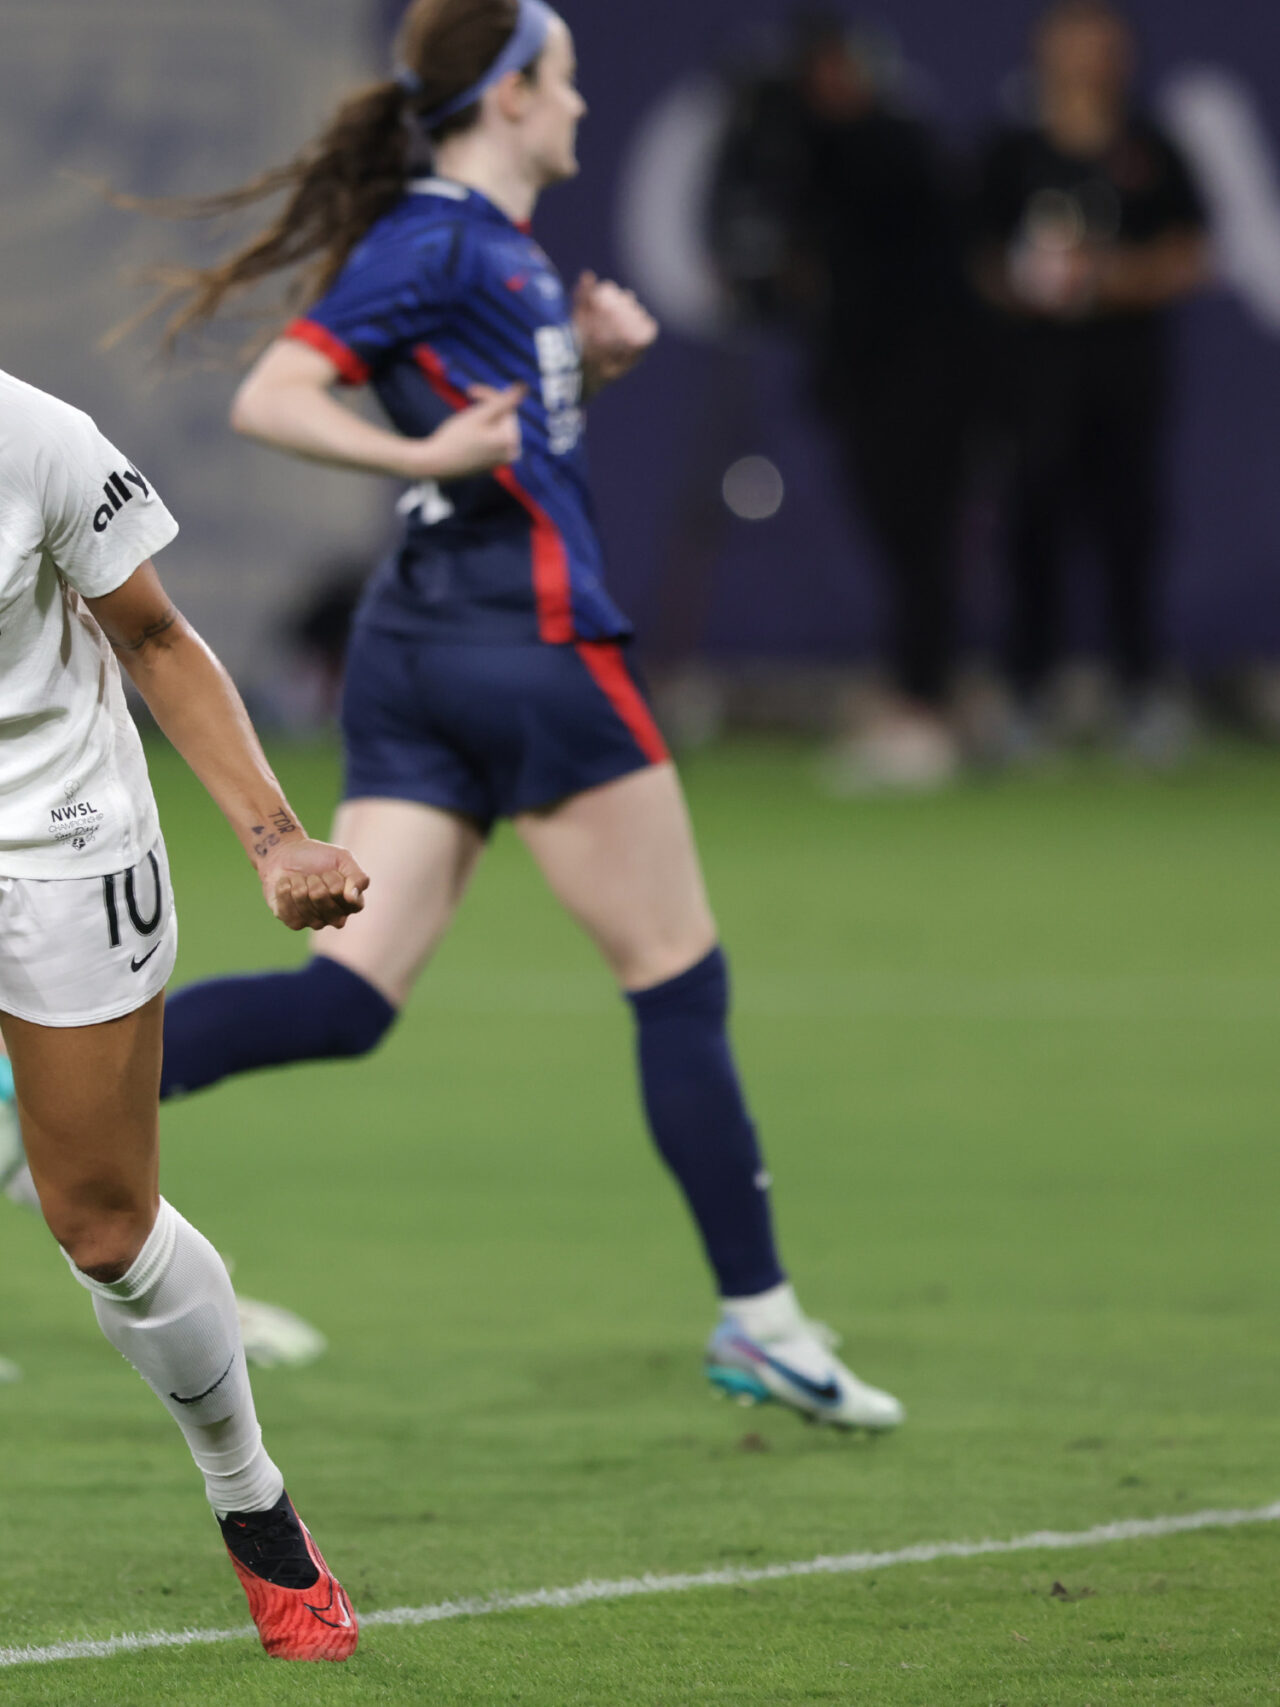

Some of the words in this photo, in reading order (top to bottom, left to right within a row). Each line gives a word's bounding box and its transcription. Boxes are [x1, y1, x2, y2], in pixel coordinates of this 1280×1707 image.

[93, 462, 149, 532] ally
[51, 802, 98, 823] NWSL
[103, 849, 161, 948] 10
